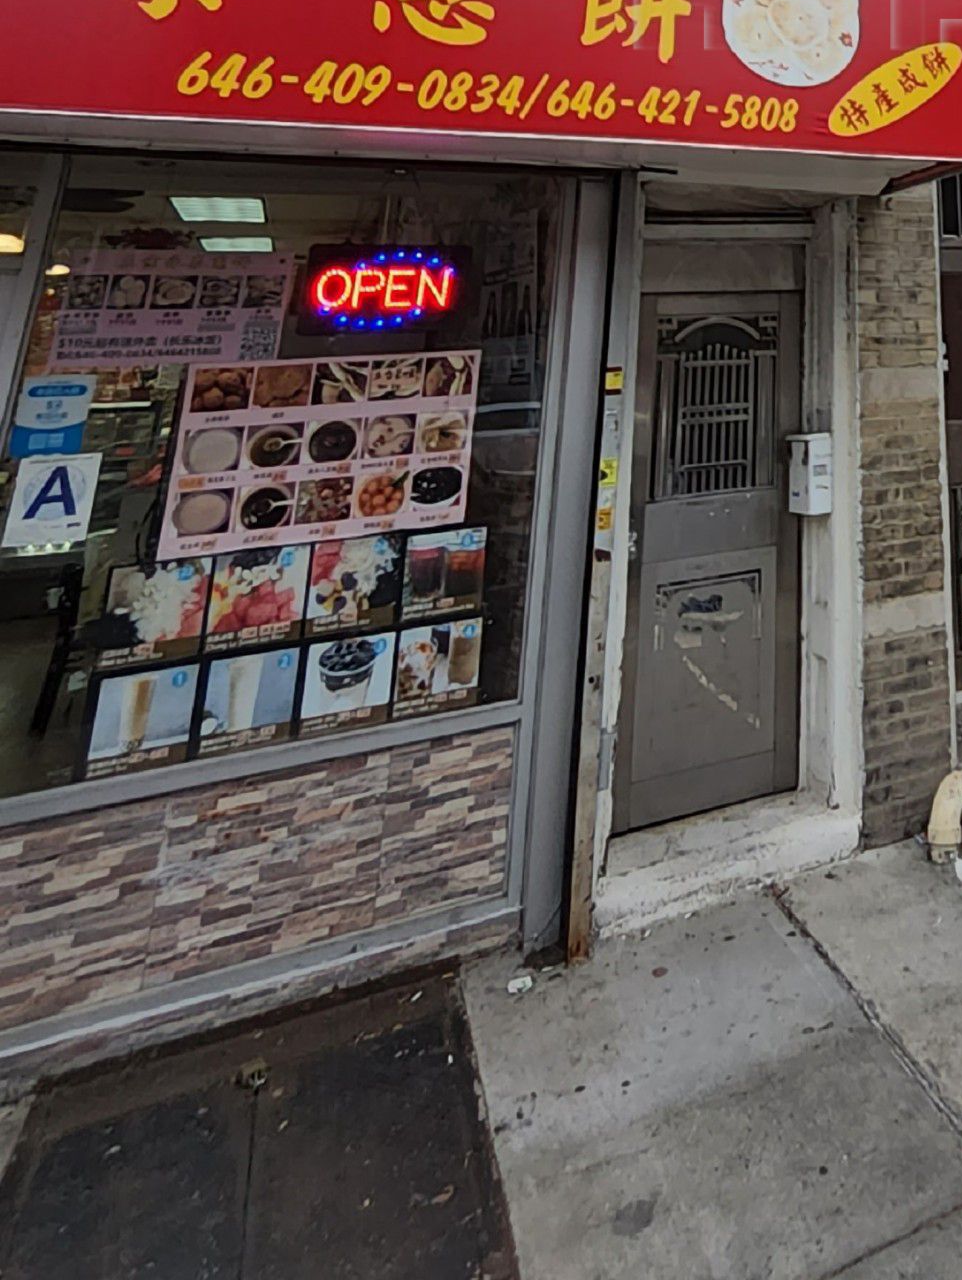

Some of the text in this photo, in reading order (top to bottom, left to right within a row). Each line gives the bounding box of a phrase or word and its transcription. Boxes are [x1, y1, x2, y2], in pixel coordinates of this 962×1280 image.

[177, 51, 800, 133] 646-409-0834/646-421-5808
[316, 267, 455, 309] OPEN
[22, 466, 76, 520] A
